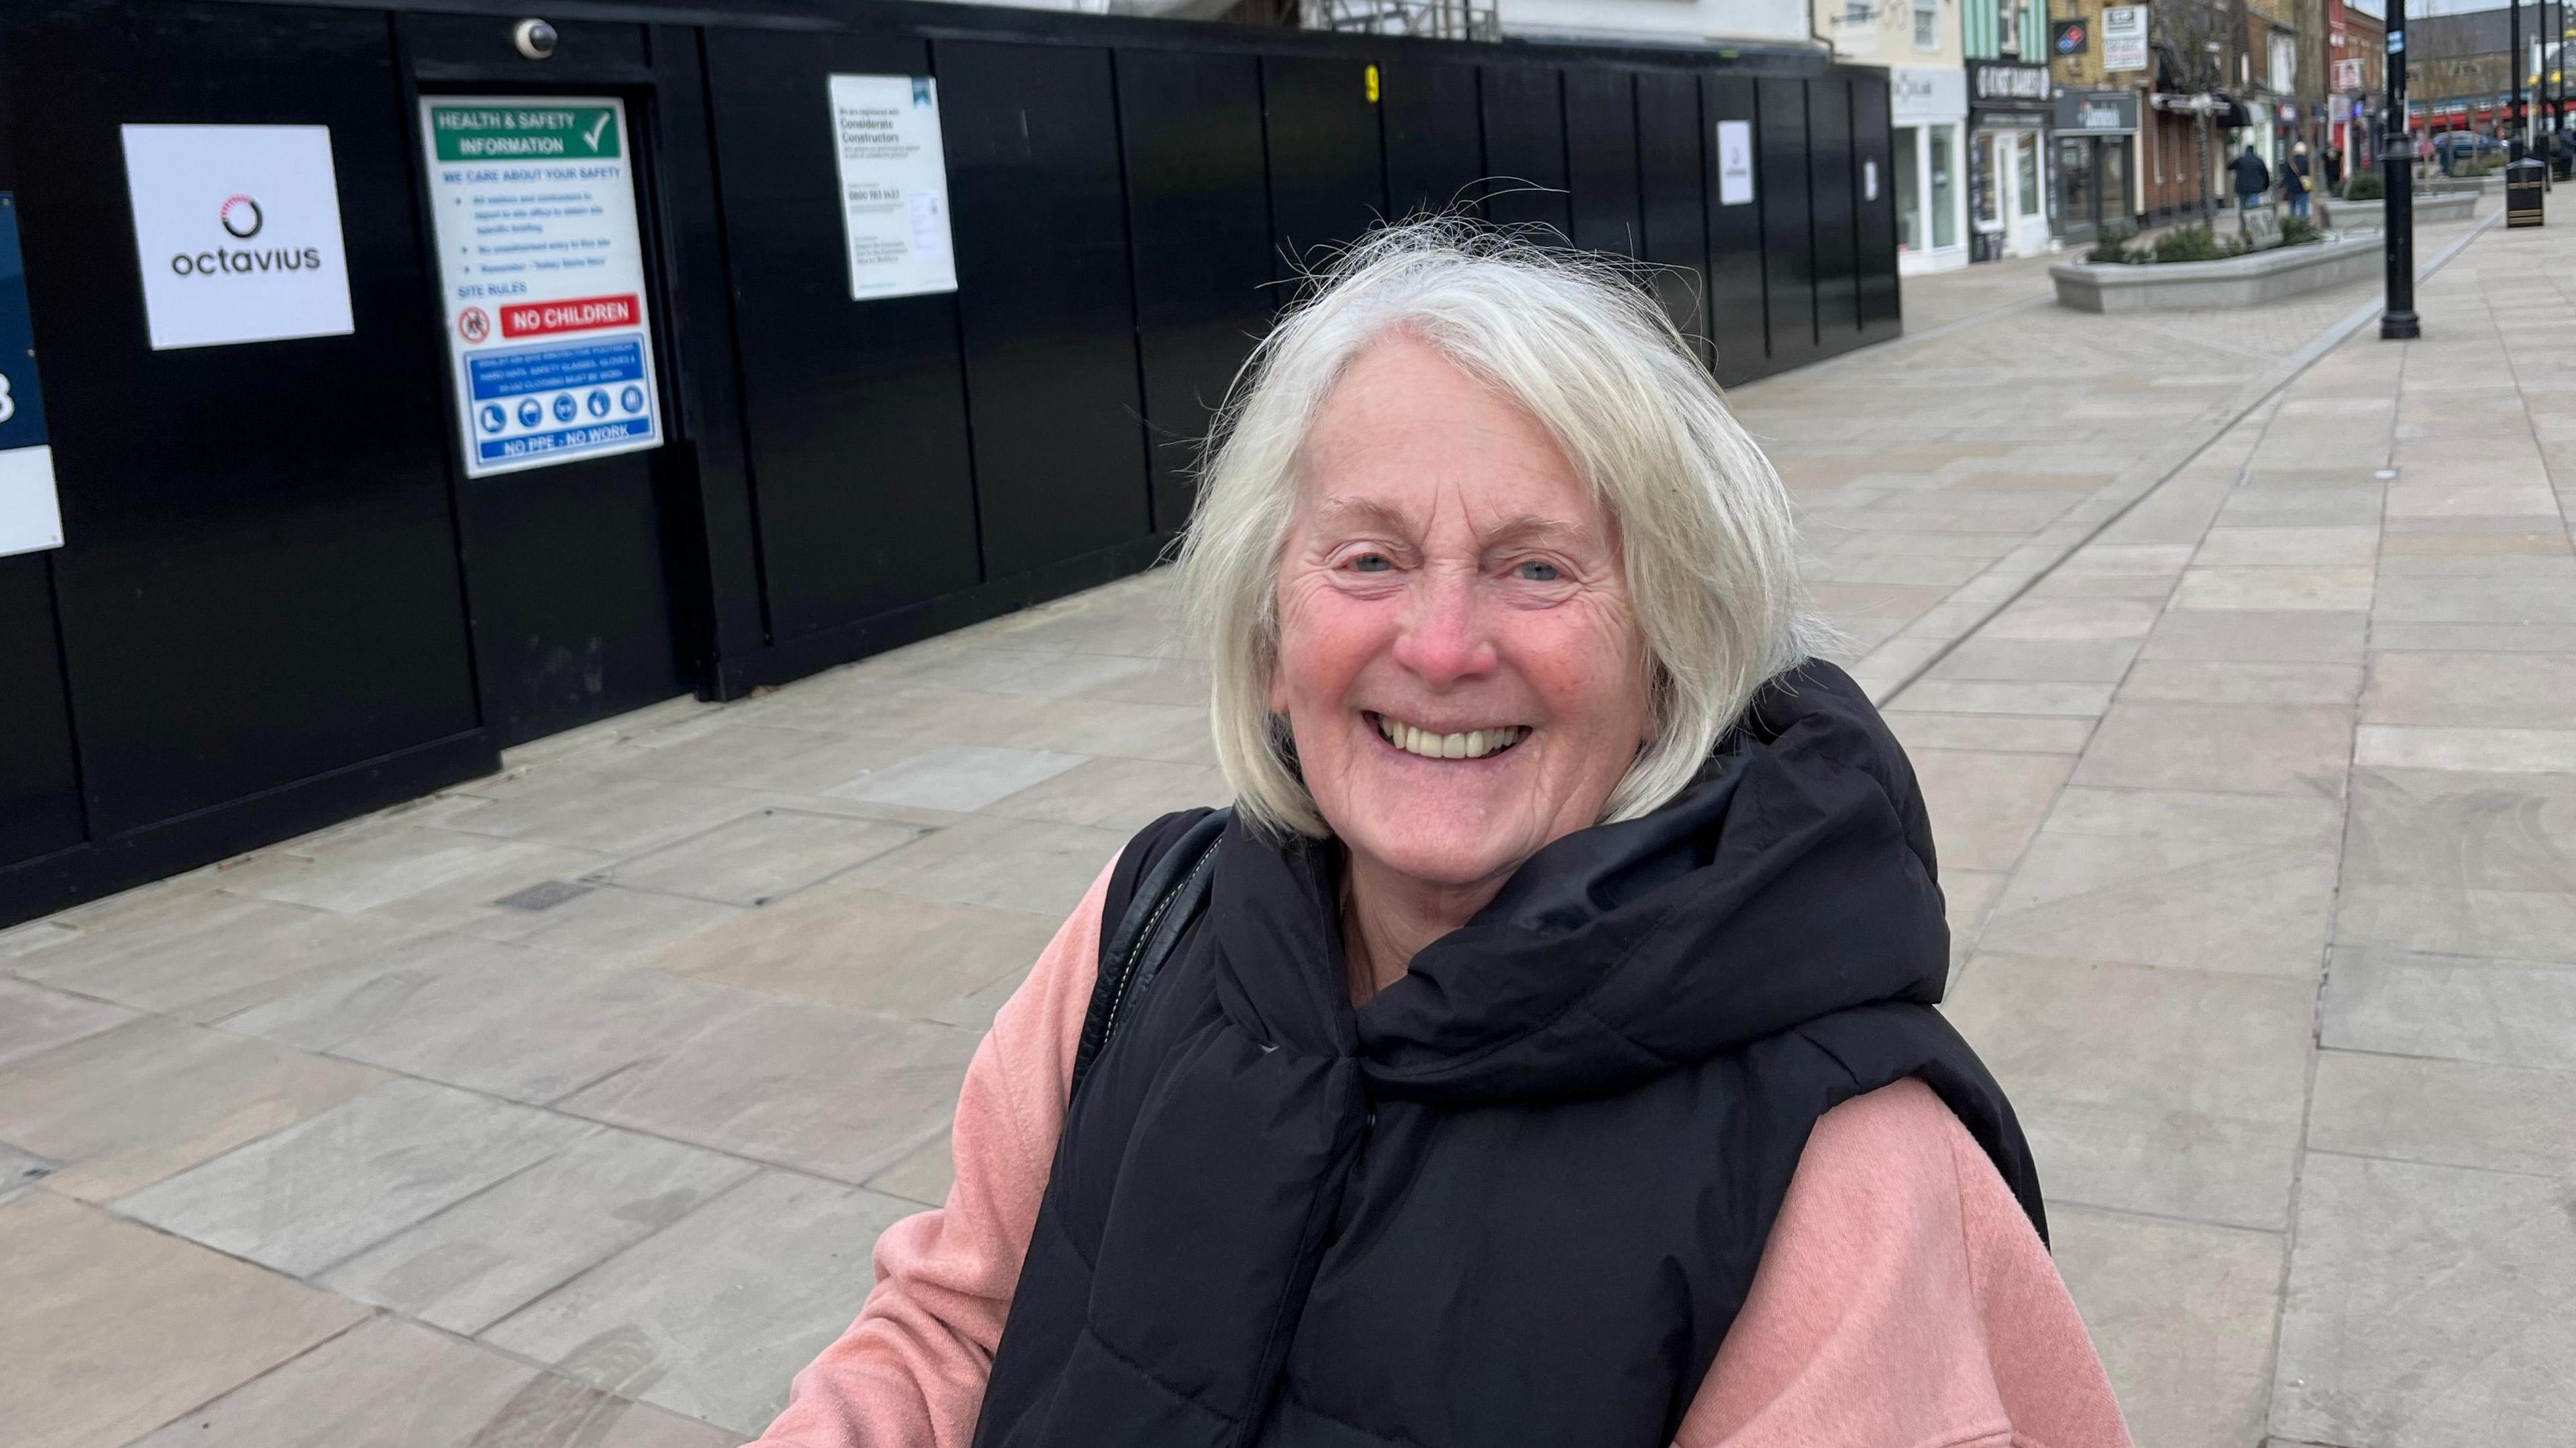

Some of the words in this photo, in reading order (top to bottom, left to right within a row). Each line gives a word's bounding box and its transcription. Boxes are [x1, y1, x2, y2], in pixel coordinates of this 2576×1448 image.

[439, 111, 501, 129] HEALTH
[505, 112, 515, 129] &
[519, 111, 574, 129] SAFETY
[841, 118, 894, 129] Considerate
[460, 137, 564, 155] INFORMATION
[843, 131, 900, 143] Constructors
[444, 171, 461, 182] WE
[467, 170, 498, 182] CARE
[503, 169, 542, 181] ABOUT
[546, 168, 577, 180] YOUR
[580, 167, 621, 178] SAFETY
[172, 245, 321, 276] octavius
[458, 284, 484, 298] SITE
[488, 281, 527, 295] RULES
[513, 311, 541, 329] NO
[544, 302, 629, 327] CHILDREN
[504, 439, 525, 455] NO
[529, 435, 555, 451] PPE
[566, 431, 586, 447] NO
[589, 424, 629, 443] WORK
